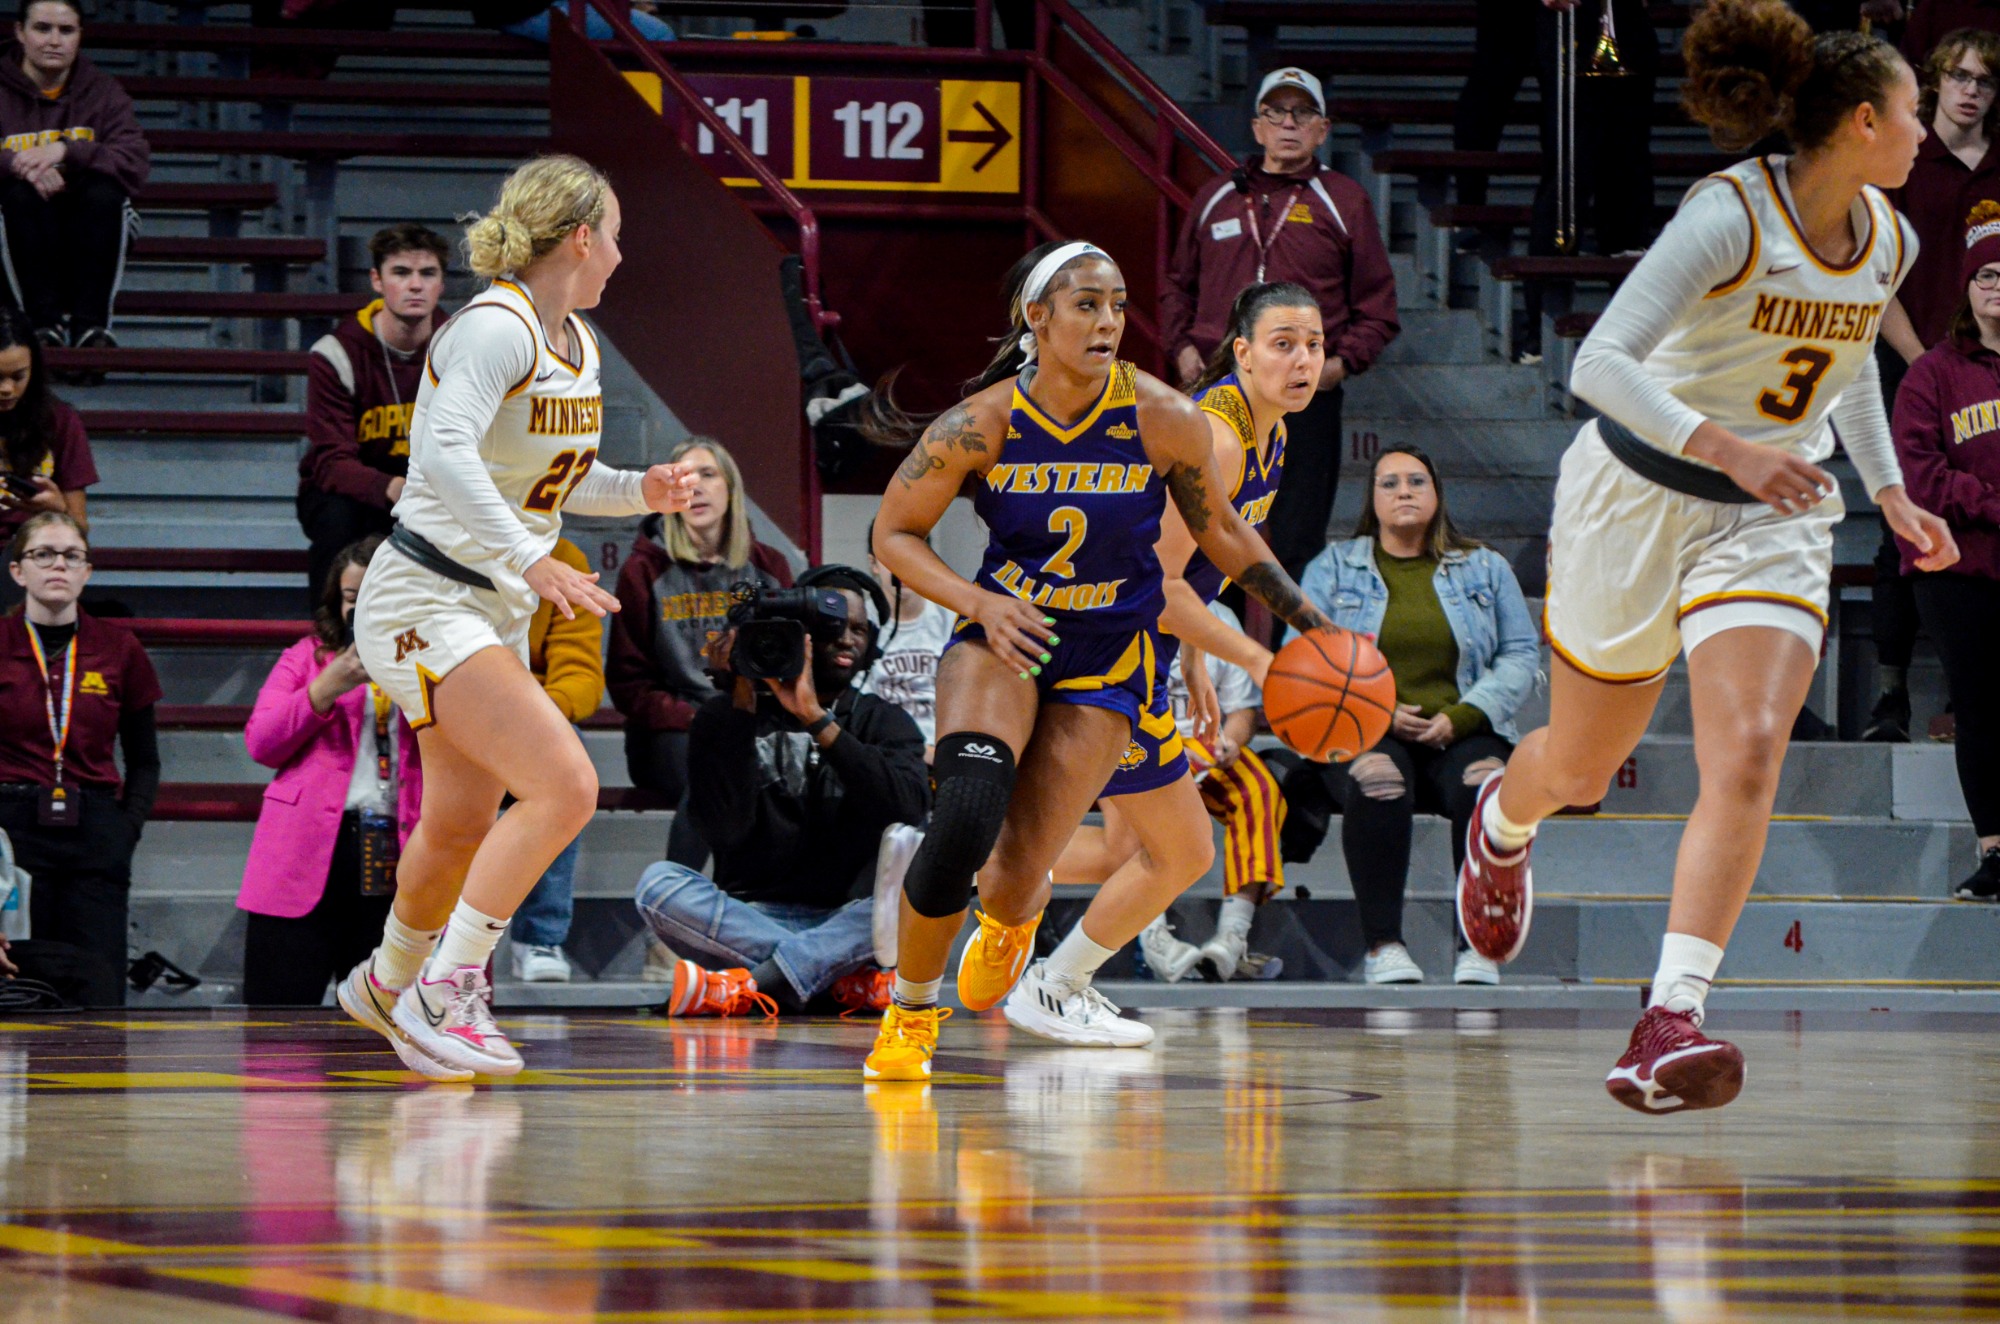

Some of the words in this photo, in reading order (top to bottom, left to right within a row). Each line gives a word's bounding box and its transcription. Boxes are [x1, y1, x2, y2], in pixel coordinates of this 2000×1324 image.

[833, 101, 924, 159] 112
[1755, 343, 1836, 425] 3
[1352, 431, 1379, 461] 10
[986, 462, 1153, 494] WESTERN
[602, 542, 618, 570] 8
[1040, 505, 1088, 579] 2
[990, 560, 1128, 611] ILLINOIS
[1617, 757, 1637, 788] 6
[1784, 920, 1803, 953] 4
